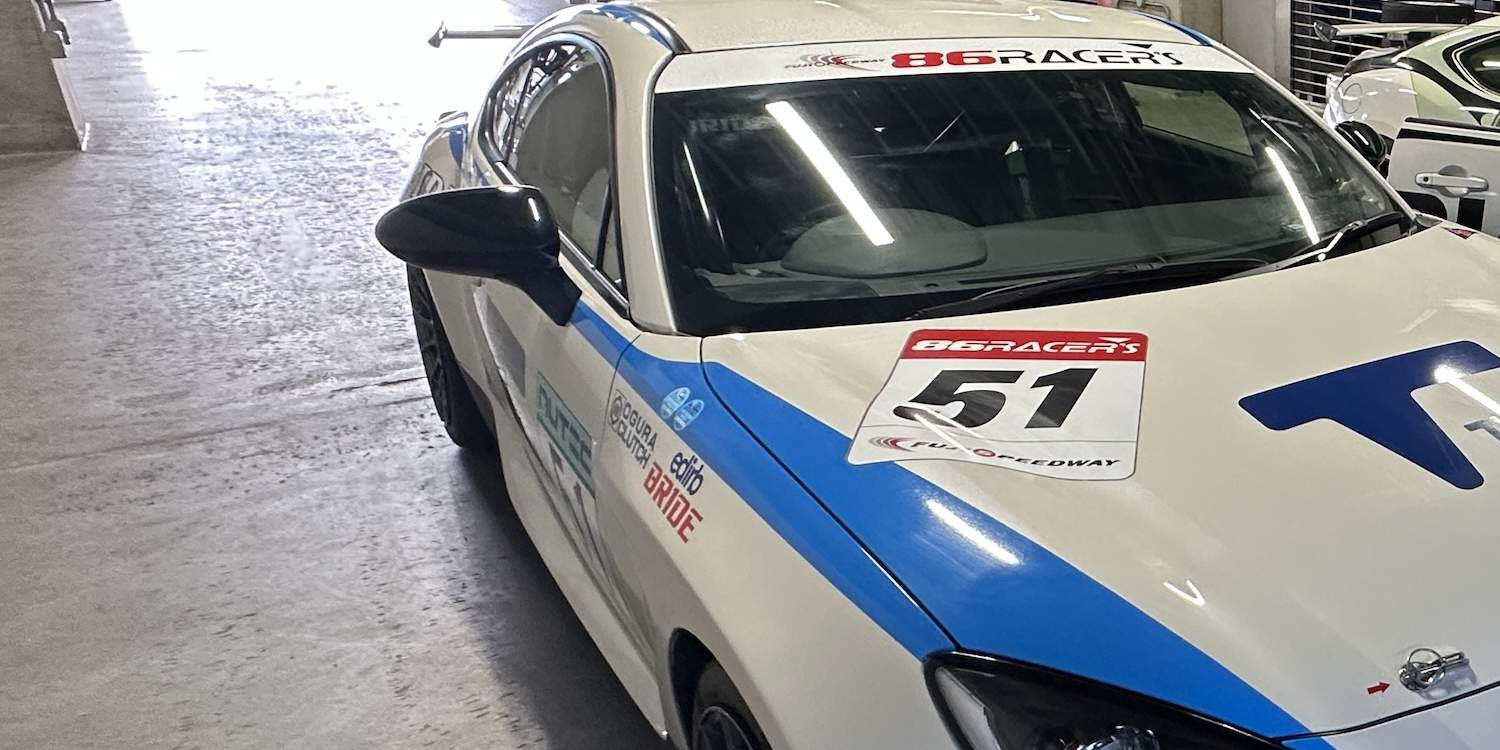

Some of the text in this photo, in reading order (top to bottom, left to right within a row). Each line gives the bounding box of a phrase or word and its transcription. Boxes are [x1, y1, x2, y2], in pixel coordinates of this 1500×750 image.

[911, 339, 1141, 354] 86RACER'S
[893, 367, 1099, 429] 51
[617, 421, 652, 469] CLUTCH
[623, 402, 658, 451] OGURA
[911, 441, 972, 451] FUJ
[643, 461, 704, 544] BRIDE
